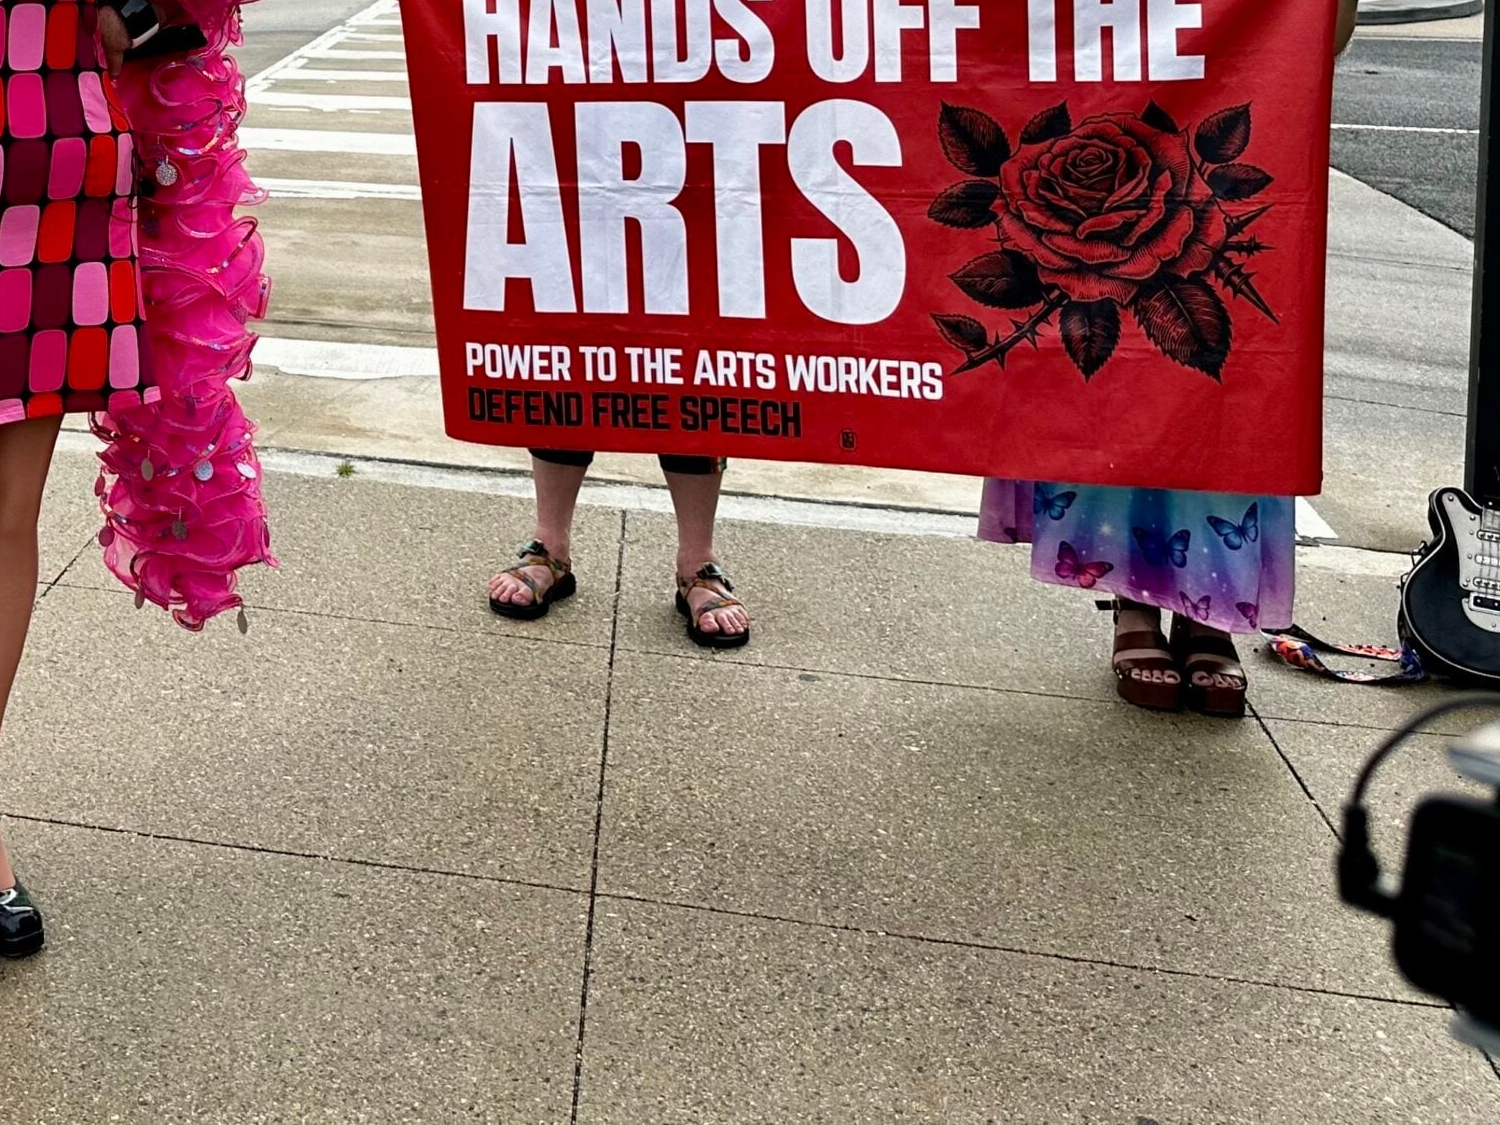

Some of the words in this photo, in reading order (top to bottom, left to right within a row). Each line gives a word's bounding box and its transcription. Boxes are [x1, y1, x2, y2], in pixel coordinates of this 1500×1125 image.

[463, 98, 907, 325] ARTS
[465, 342, 572, 381] POWER
[578, 346, 617, 382] TO
[624, 347, 685, 385] THE
[693, 349, 776, 390] ARTS
[785, 354, 944, 401] WORKERS
[467, 386, 583, 427] DEFEND
[592, 391, 671, 431] FREE
[680, 395, 802, 438] SPEECH
